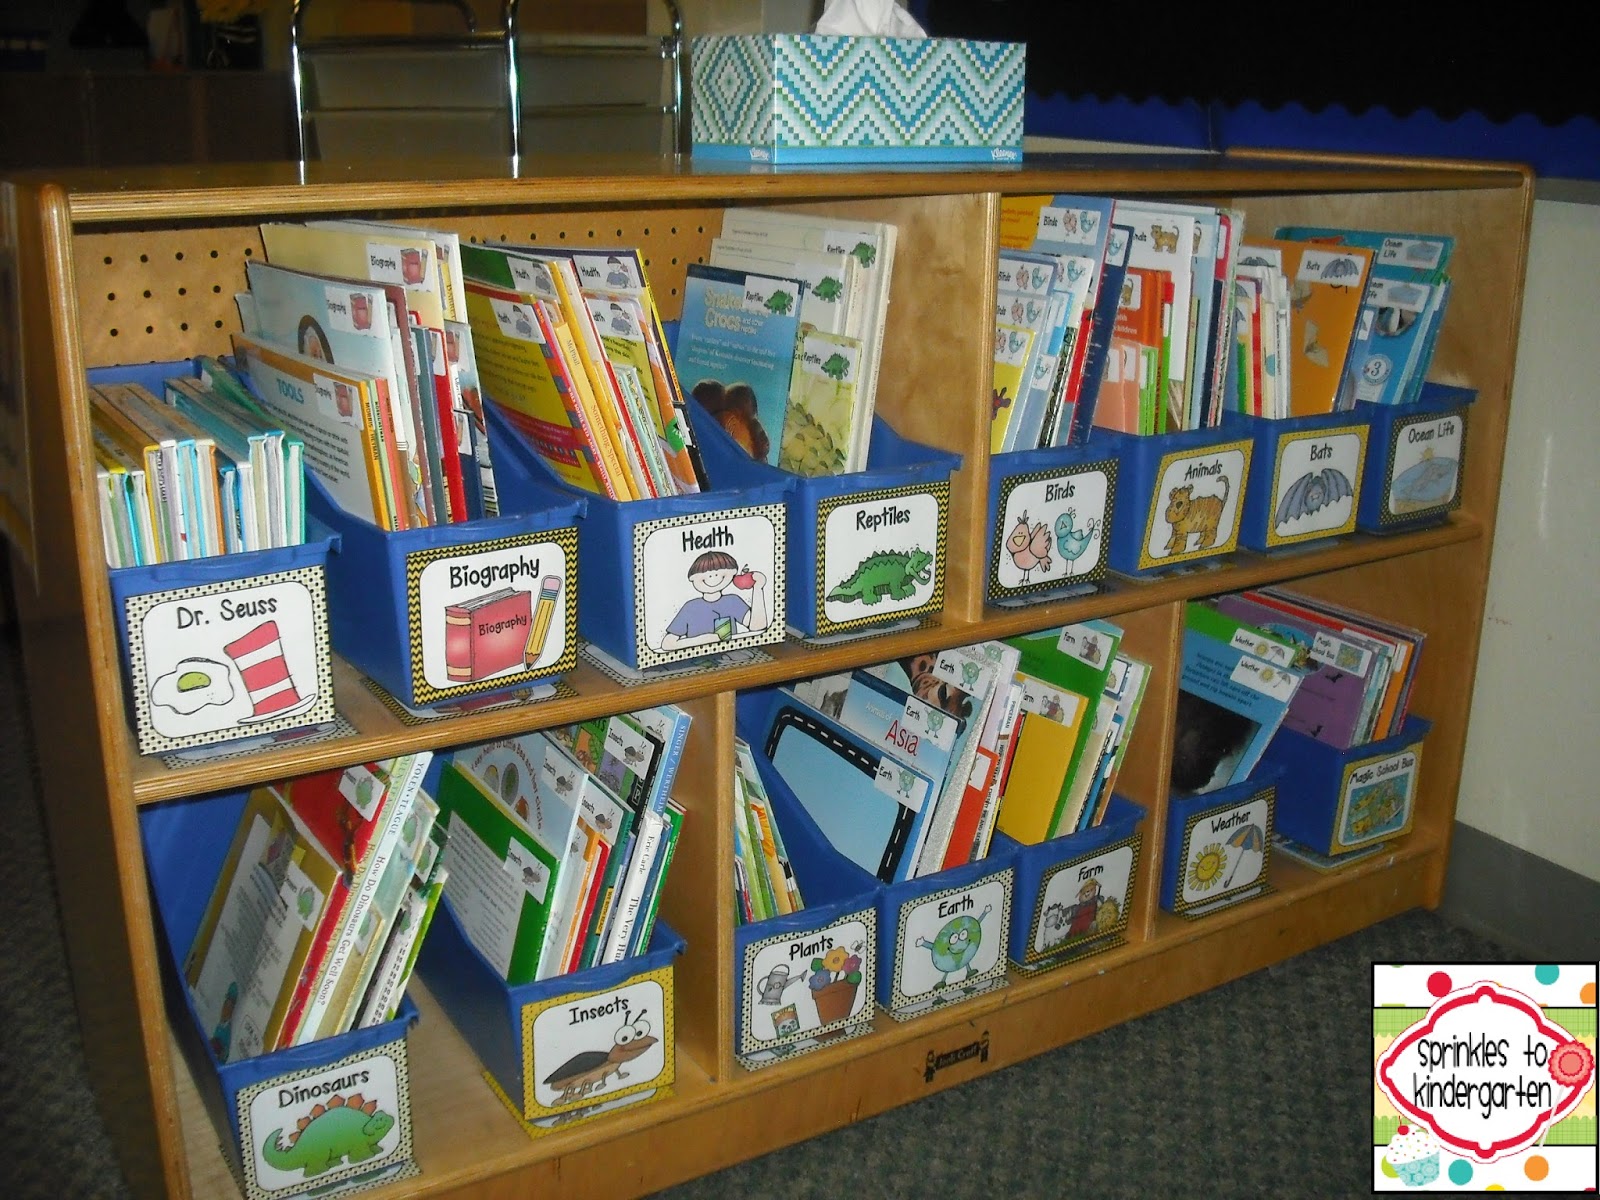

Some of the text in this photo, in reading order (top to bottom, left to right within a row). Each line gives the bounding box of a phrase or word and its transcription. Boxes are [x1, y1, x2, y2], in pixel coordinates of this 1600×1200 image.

[580, 266, 601, 278] Health
[1306, 261, 1320, 271] Bats
[745, 290, 764, 303] Reptiles
[705, 307, 741, 331] Crocs
[566, 339, 580, 367] McPhail
[803, 352, 822, 365] Reptiles
[1370, 361, 1382, 377] 3
[276, 378, 304, 405] TOOLS
[591, 404, 623, 477] Something Special
[1408, 421, 1455, 444] Ocean Life
[1310, 443, 1333, 462] Bats
[1184, 461, 1223, 481] Animals
[1045, 481, 1076, 503] Birds
[856, 506, 911, 532] Reptiles
[682, 526, 734, 552] Health
[449, 554, 541, 590] Biography
[176, 596, 278, 630] Dr. Seuss
[477, 613, 528, 637] Biography
[939, 659, 955, 675] Earth
[906, 705, 921, 721] Earth
[608, 727, 624, 747] Insects
[672, 724, 687, 756] SINGER
[885, 719, 919, 757] Asia
[879, 765, 893, 781] Earth
[1350, 758, 1414, 785] Magic School Bus
[389, 763, 424, 835] YOLEN TEAGUE
[657, 766, 675, 812] WERTHEIM
[1211, 811, 1251, 834] Weather
[644, 836, 655, 851] Eric
[639, 853, 651, 875] Carle
[1077, 863, 1104, 882] Farm
[628, 897, 640, 916] The
[938, 896, 974, 920] Earth
[317, 856, 386, 1006] How Do Dinosaurs Get Well Soon?
[618, 917, 634, 939] Very
[789, 934, 834, 961] Plants
[569, 995, 629, 1026] Insects
[278, 1068, 371, 1109] Dinosaurs
